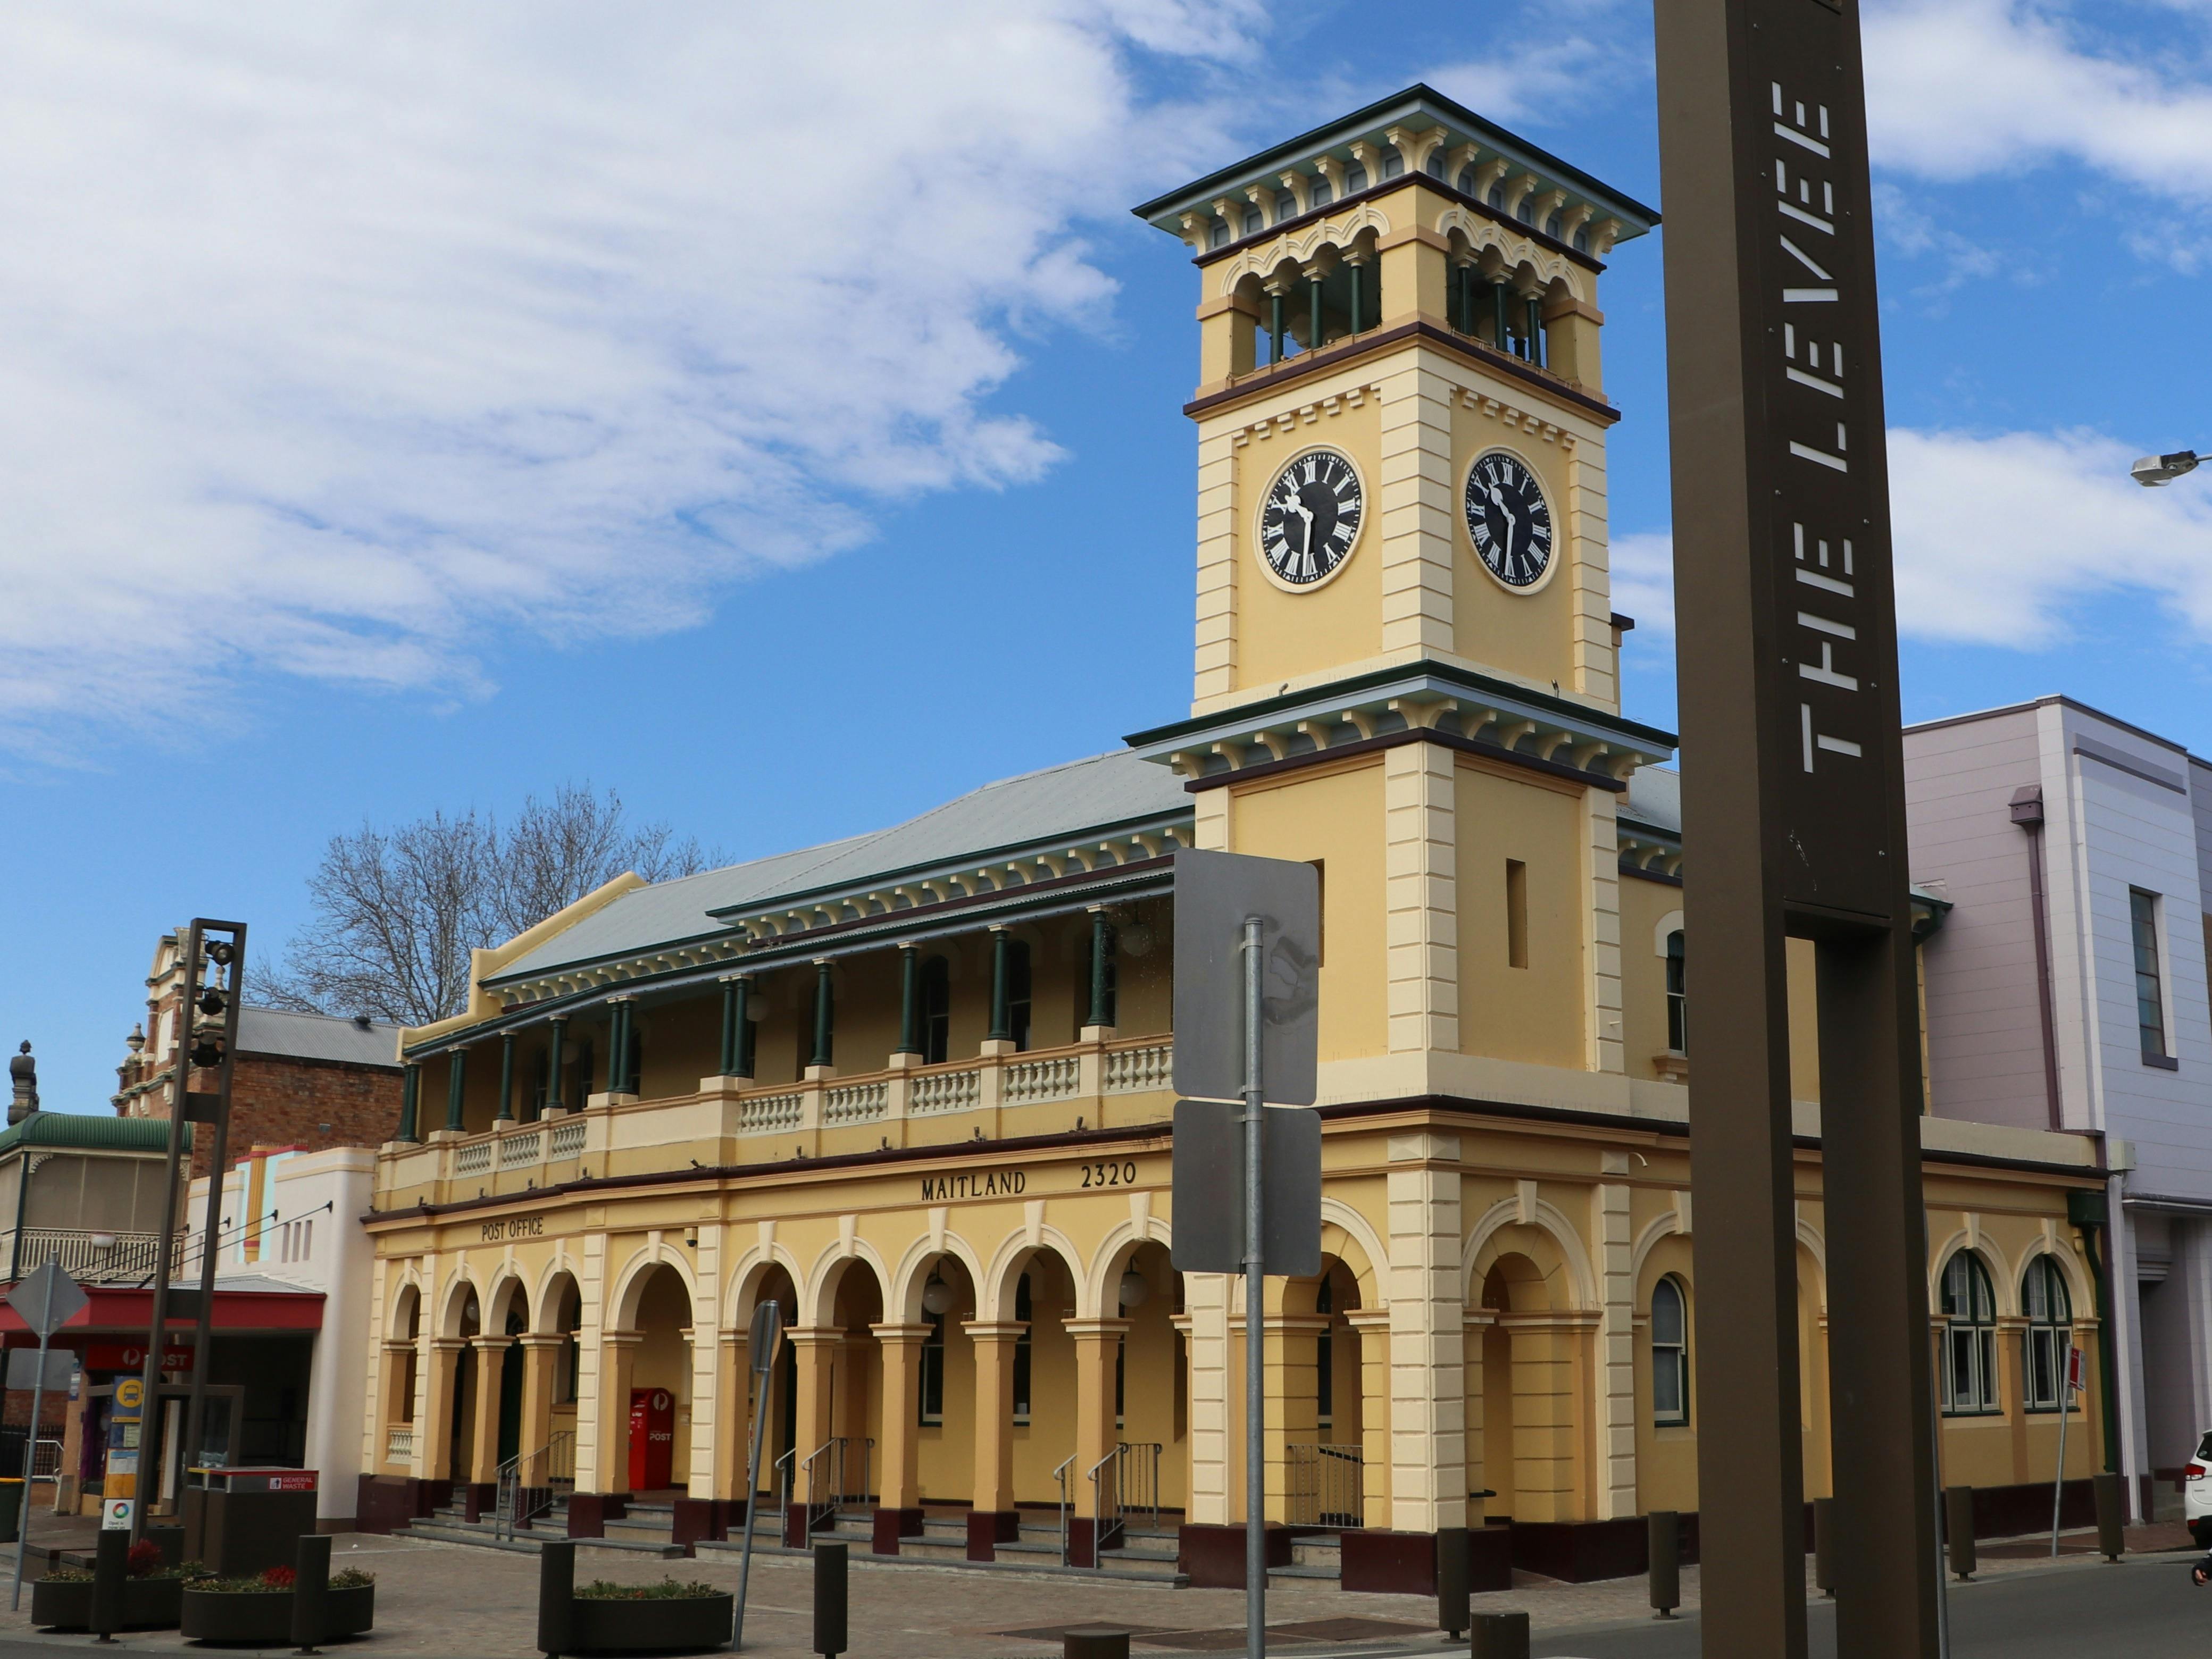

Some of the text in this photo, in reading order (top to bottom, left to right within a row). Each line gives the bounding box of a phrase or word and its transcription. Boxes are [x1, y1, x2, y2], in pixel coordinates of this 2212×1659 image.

[1771, 80, 1862, 774] THE LEVEE
[1303, 460, 1317, 486] XII
[1322, 460, 1334, 484] I
[1501, 462, 1514, 487] XII
[1332, 473, 1351, 496] II
[1472, 474, 1490, 499] X
[1518, 476, 1529, 496] I
[1338, 497, 1356, 516] III
[1471, 499, 1485, 518] IX
[1527, 499, 1543, 515] II
[1267, 521, 1284, 540] IX
[1532, 522, 1548, 540] III
[1323, 542, 1339, 565] V
[1520, 554, 1533, 577] V
[921, 1161, 1137, 1201] MAITLAND 2320
[482, 1217, 544, 1242] POST OFFICE
